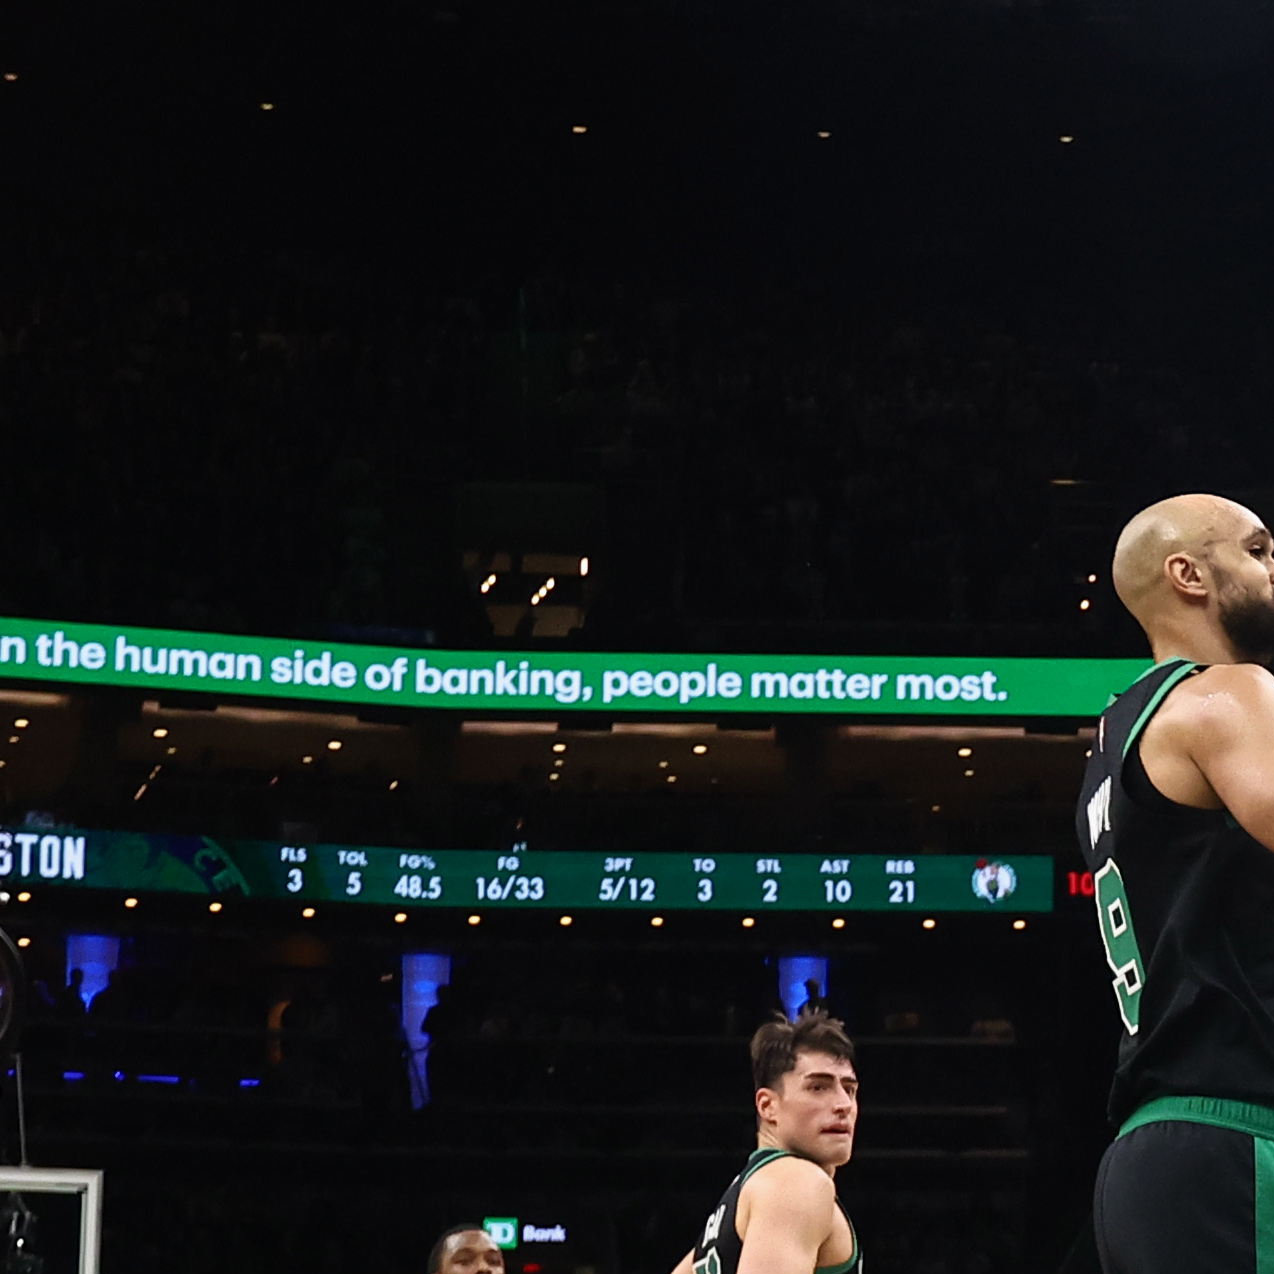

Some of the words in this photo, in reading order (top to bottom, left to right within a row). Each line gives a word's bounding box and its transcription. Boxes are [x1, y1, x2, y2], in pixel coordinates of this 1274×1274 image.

[35, 630, 106, 670] the
[115, 635, 262, 681] human
[270, 649, 357, 687] side
[365, 657, 408, 692] of
[415, 658, 593, 704] banking,
[602, 662, 742, 704] people
[750, 669, 888, 700] matter
[896, 671, 1008, 701] most.
[399, 853, 436, 870] FG%
[497, 856, 520, 871] FG
[604, 857, 634, 872] 3PT
[693, 858, 716, 873] TO
[756, 859, 782, 873] STL
[820, 859, 850, 874] AST
[287, 868, 303, 893] 3
[346, 871, 362, 895] 5
[394, 874, 442, 900] 48.5
[475, 874, 545, 901] 16/33
[598, 876, 656, 902] 5/12
[697, 878, 713, 902] 3
[762, 879, 778, 903] 2
[824, 880, 851, 903] 10
[888, 880, 915, 903] 21
[522, 1223, 567, 1242] Bank
